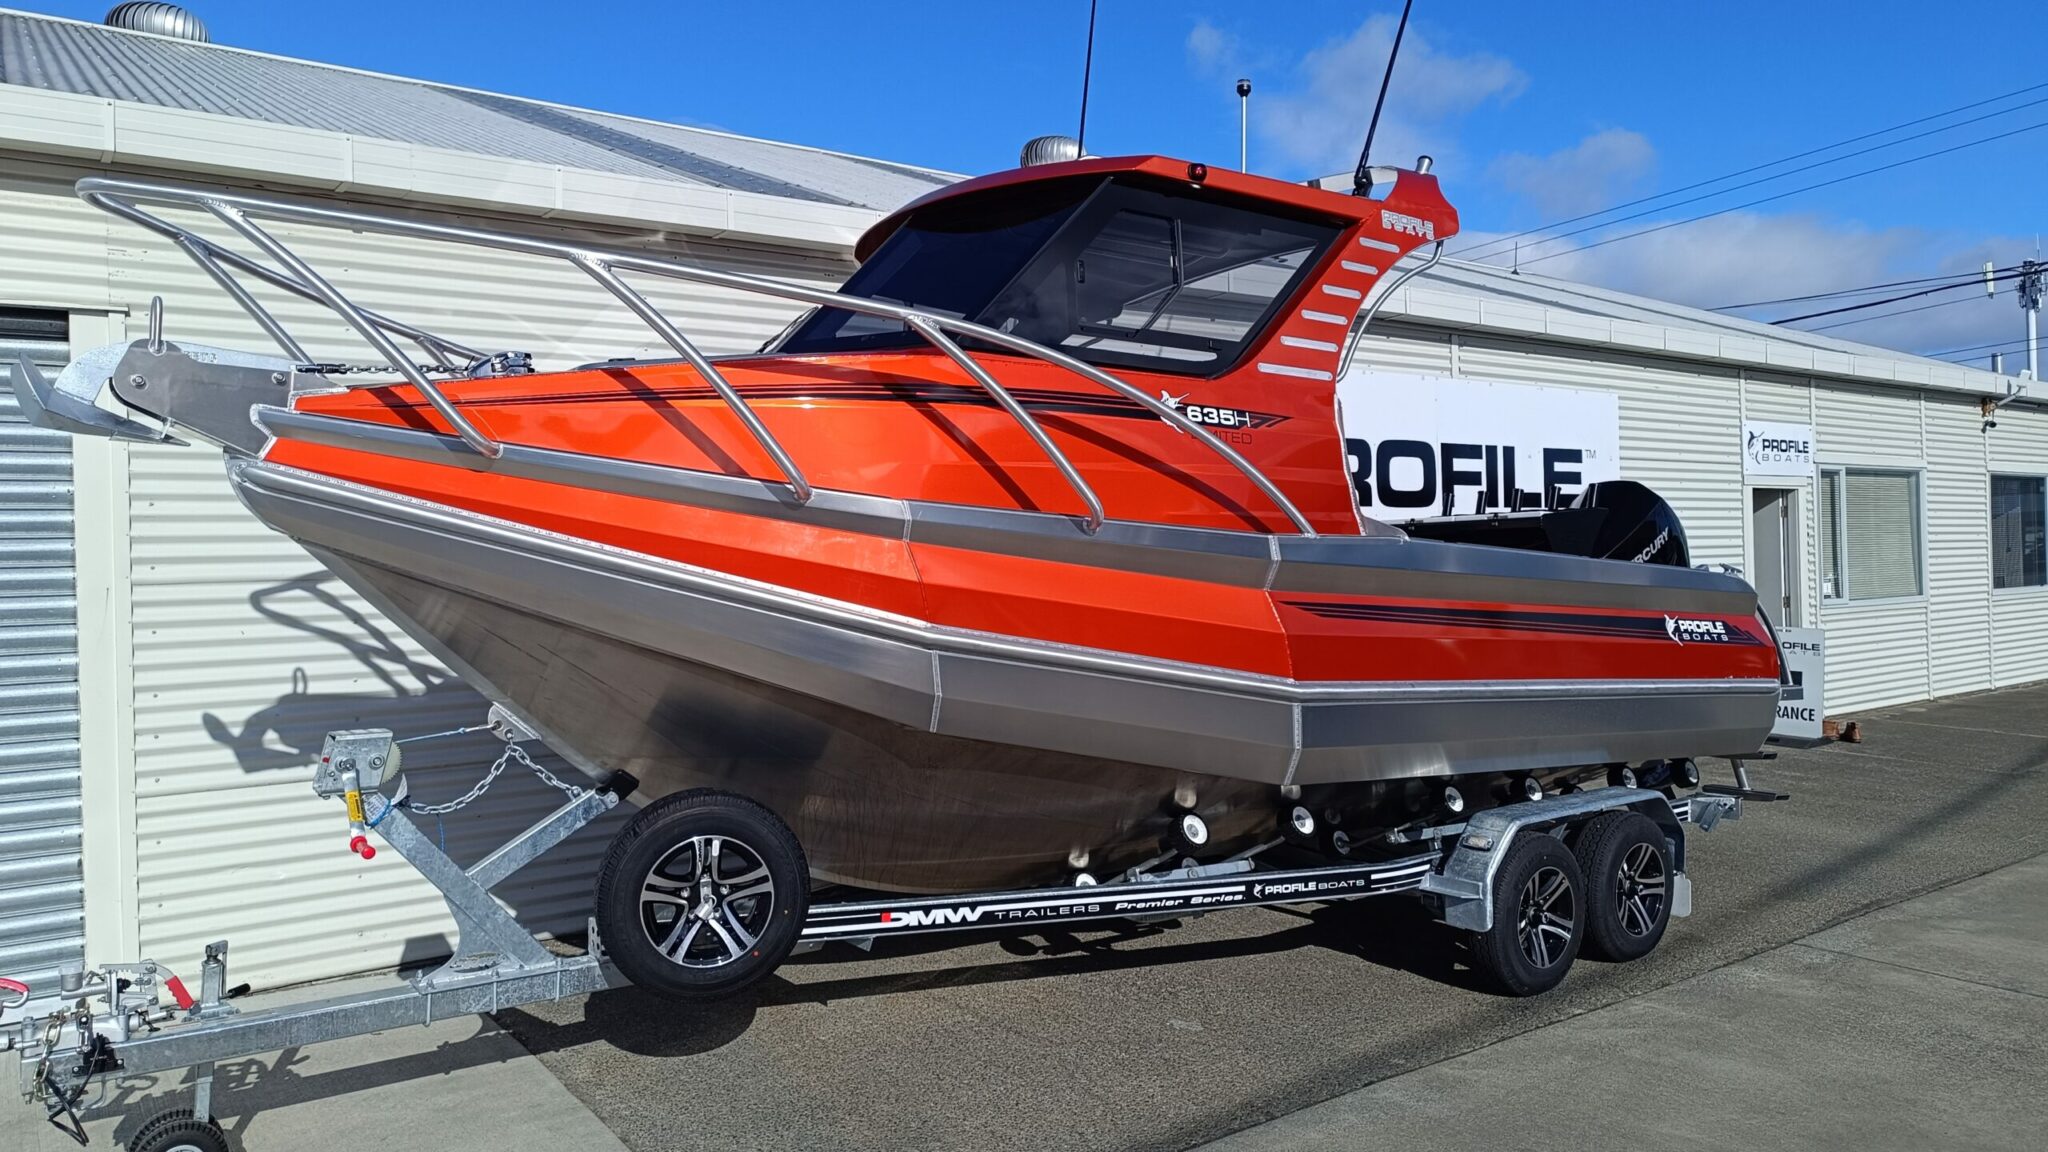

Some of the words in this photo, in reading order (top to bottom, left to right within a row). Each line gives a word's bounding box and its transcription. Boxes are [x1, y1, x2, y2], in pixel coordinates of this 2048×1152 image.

[1186, 406, 1252, 428] 635H
[1191, 430, 1252, 445] ITED
[1762, 439, 1809, 453] PROFILE
[1761, 453, 1810, 463] BOATS
[1345, 437, 1583, 509] ROFILE
[1631, 526, 1669, 563] RCURY
[1678, 620, 1726, 634] PROFILE
[1682, 633, 1729, 642] BOATS
[1782, 641, 1821, 652] OFILE
[1776, 705, 1816, 722] RANCE
[1264, 881, 1317, 895] PROFILE
[1318, 879, 1366, 890] BOATS
[1115, 898, 1184, 911] Premier
[881, 907, 987, 927] DMW
[994, 904, 1101, 920] TRAILERS
